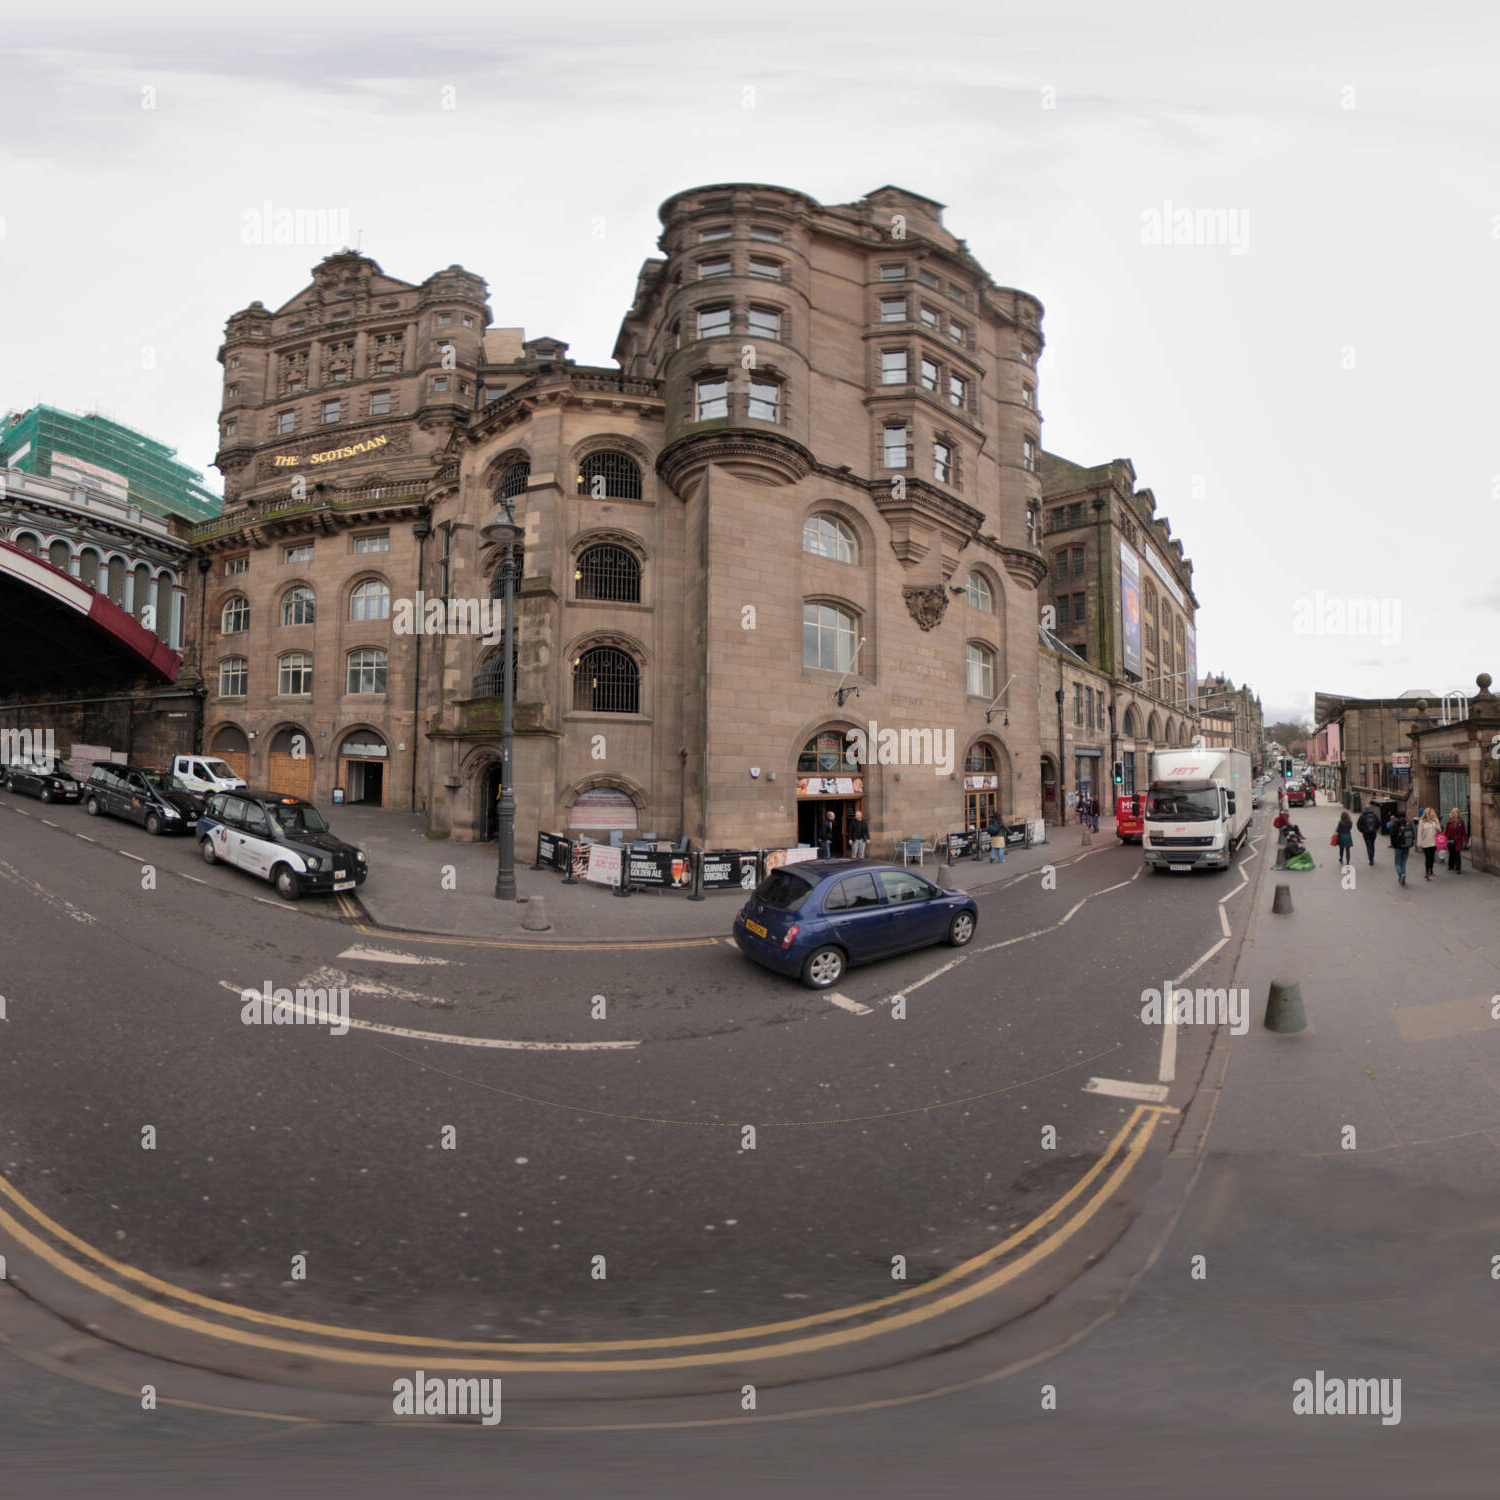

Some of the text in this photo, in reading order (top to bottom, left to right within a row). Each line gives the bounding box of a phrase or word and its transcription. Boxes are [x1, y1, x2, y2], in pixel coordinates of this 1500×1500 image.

[274, 435, 387, 467] THE SCOTSMAN
[630, 861, 658, 870] GUINNESS
[704, 863, 731, 873] GUINNESS
[630, 868, 663, 878] GOLDEN ALE
[703, 872, 729, 881] ORIGINAL
